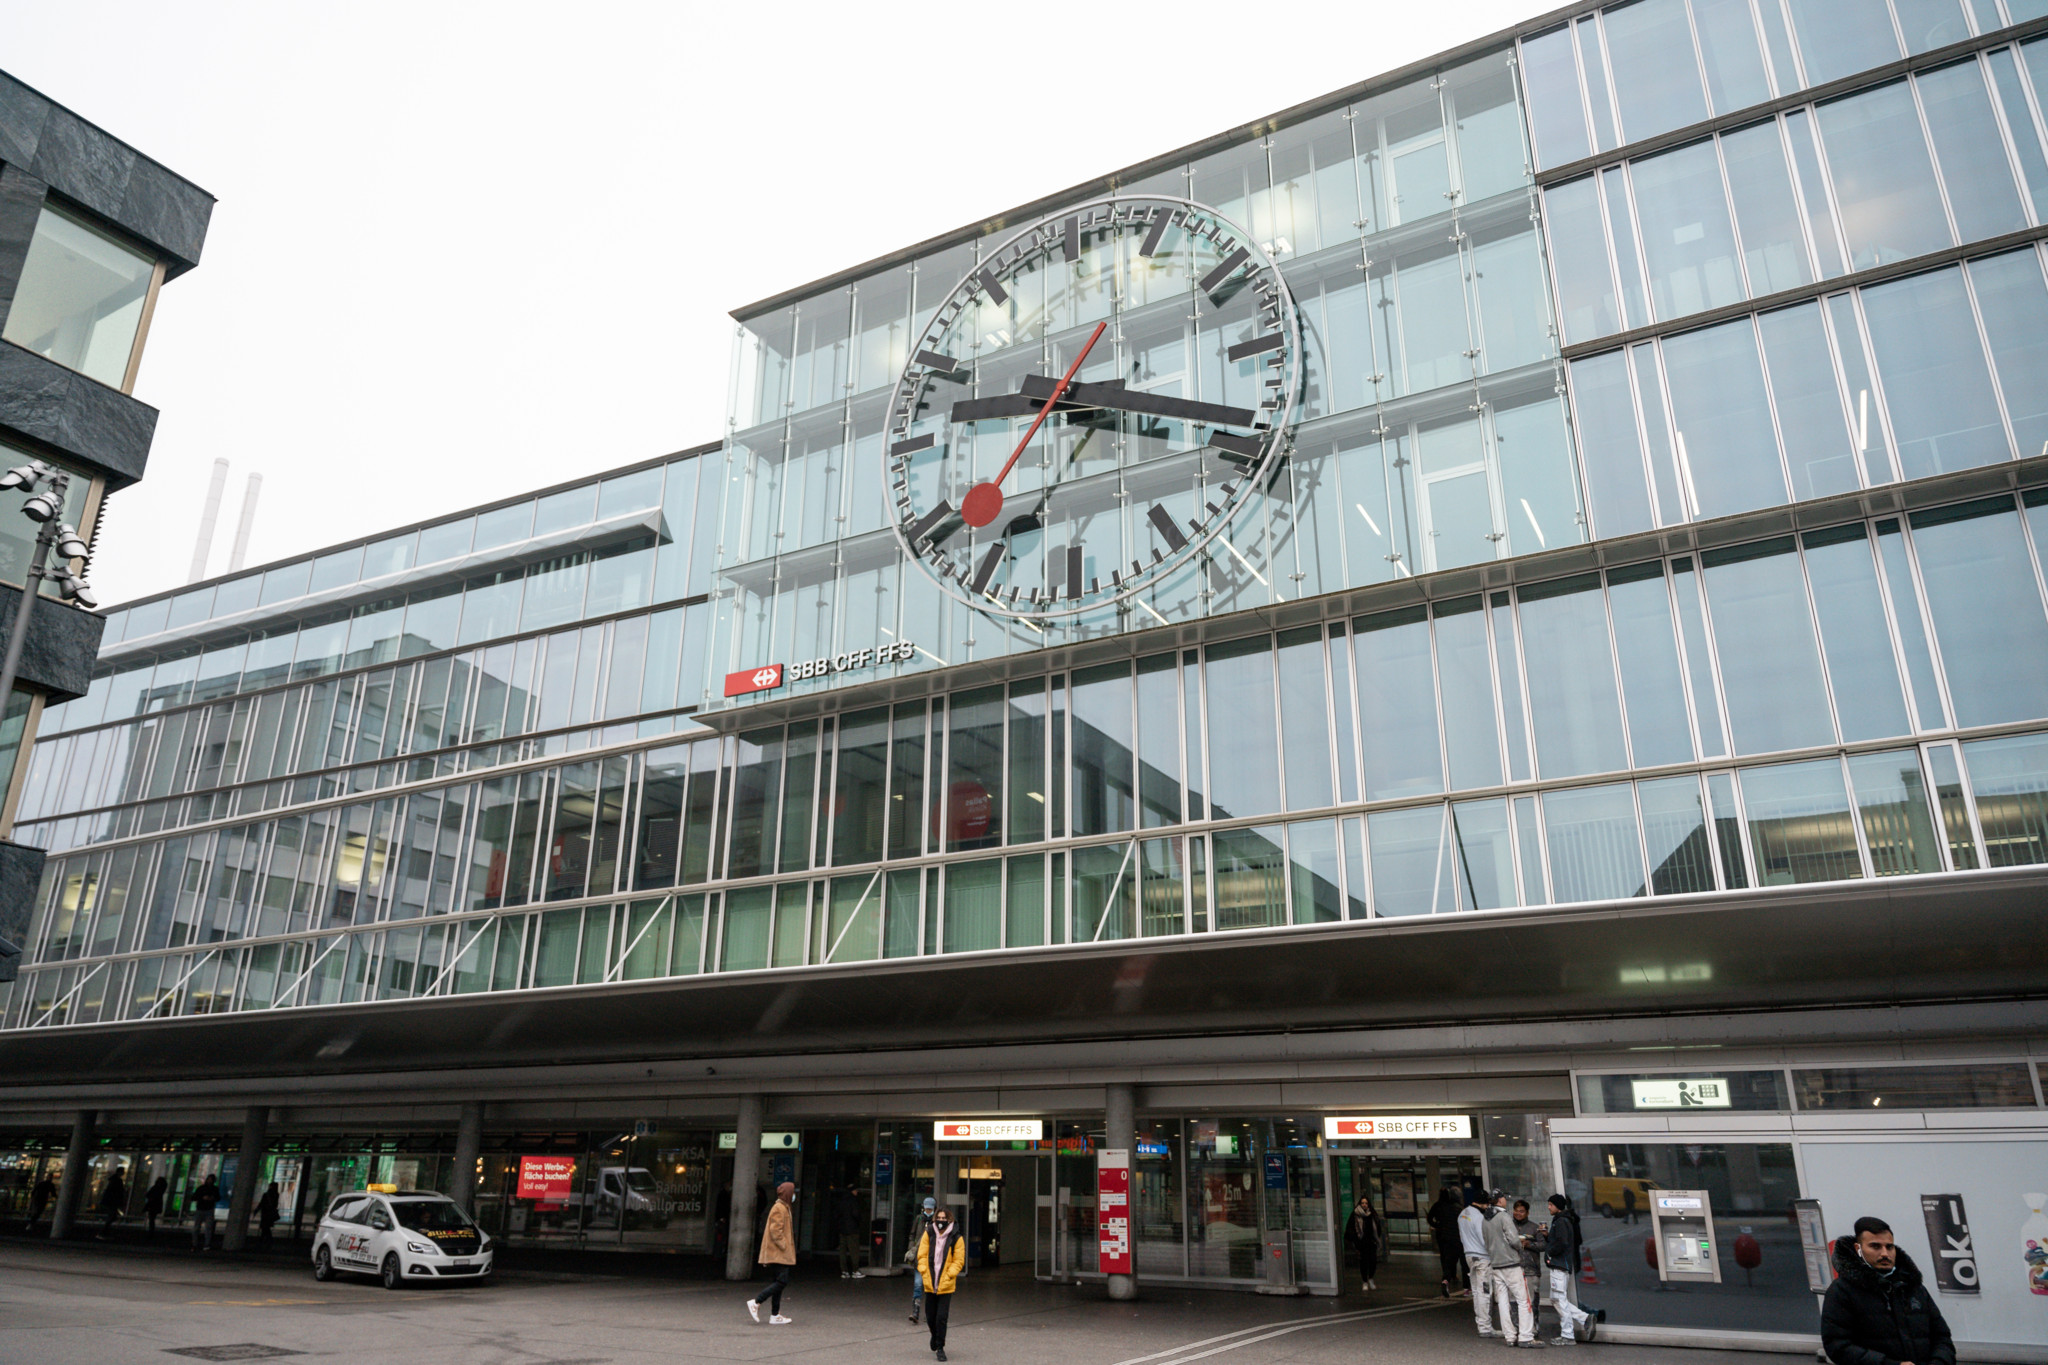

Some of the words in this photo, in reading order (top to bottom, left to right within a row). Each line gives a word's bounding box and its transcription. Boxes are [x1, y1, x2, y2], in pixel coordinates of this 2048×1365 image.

[789, 657, 829, 681] SBB
[834, 648, 872, 672] CFF
[877, 640, 915, 664] FFS
[973, 1126, 992, 1135] SBB
[994, 1126, 1010, 1135] CFF
[1014, 1126, 1032, 1134] FFS
[1378, 1122, 1402, 1132] SBB
[1406, 1122, 1429, 1132] CFF
[1433, 1121, 1457, 1132] FFS
[682, 1147, 705, 1160] KSA
[525, 1162, 542, 1170] Diese
[544, 1163, 566, 1171] Werbe-
[524, 1172, 543, 1180] fläche
[544, 1172, 570, 1180] buchen?
[686, 1167, 704, 1177] am
[1120, 1170, 1128, 1181] 0
[534, 1183, 549, 1192] easy!
